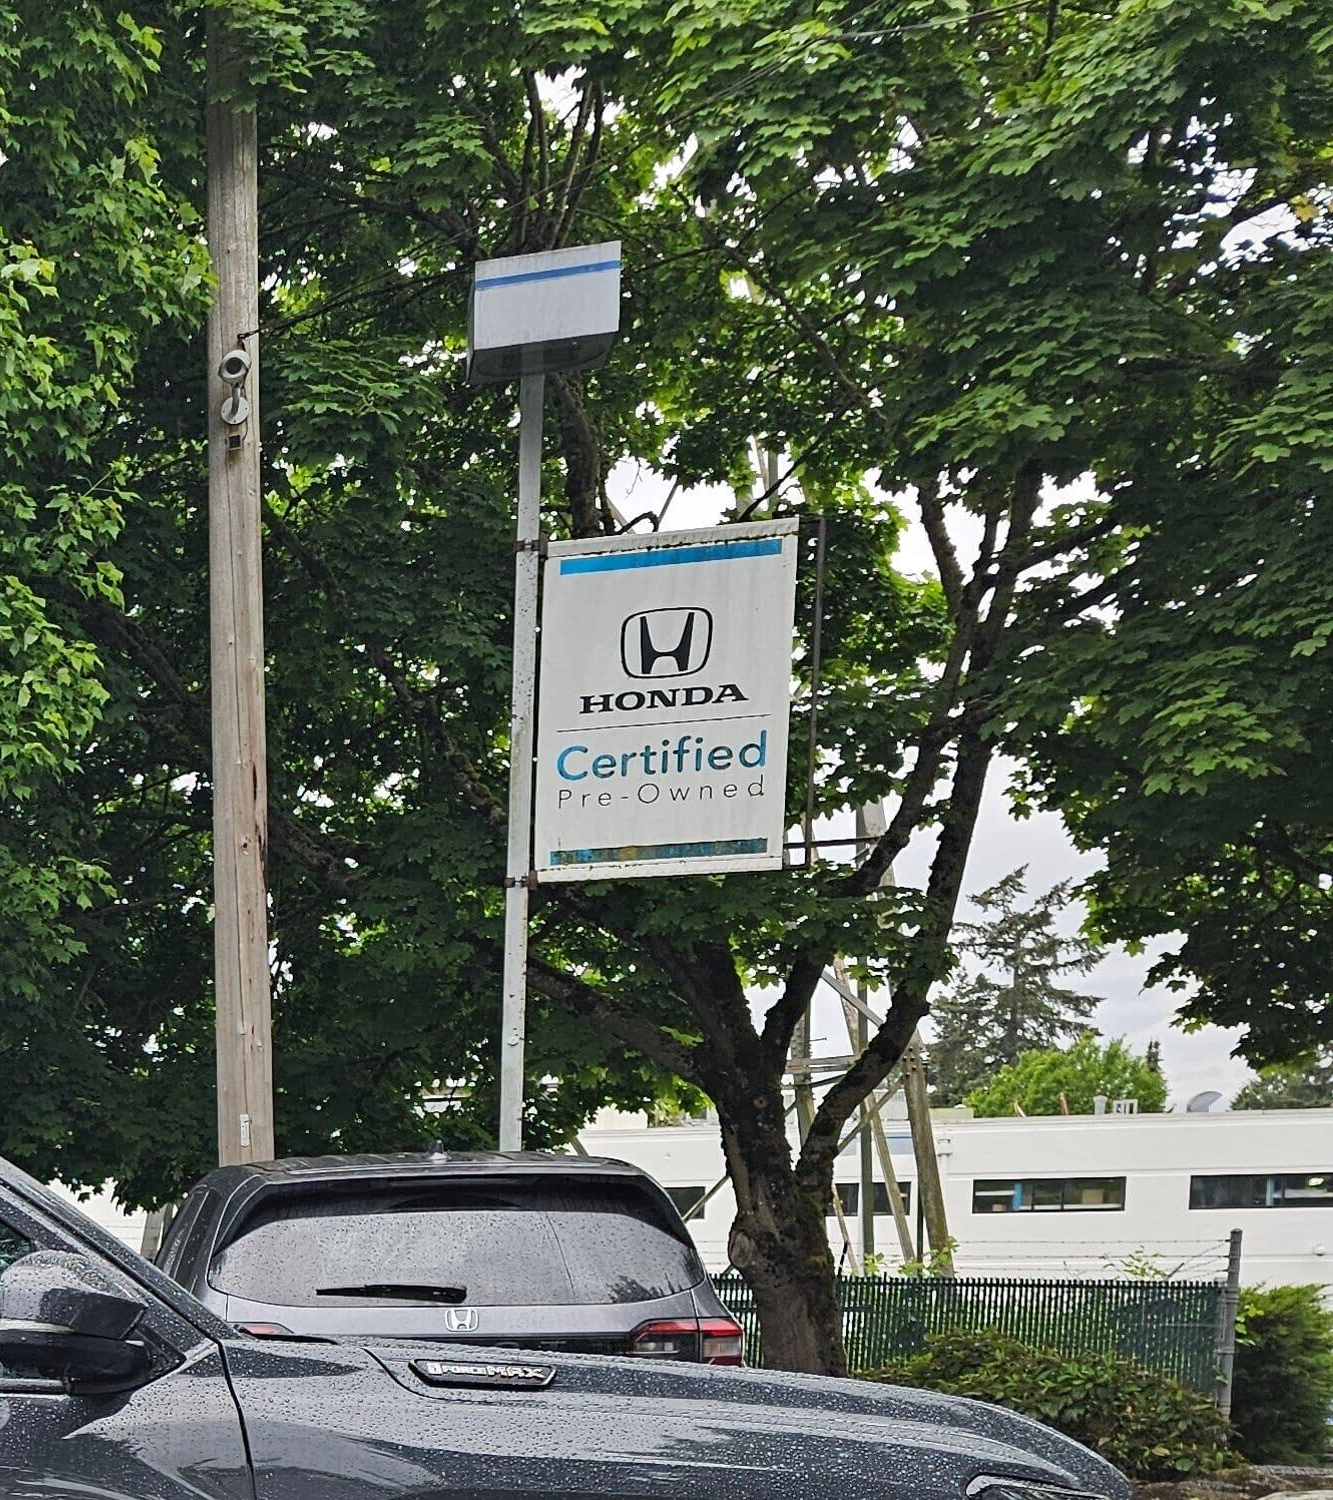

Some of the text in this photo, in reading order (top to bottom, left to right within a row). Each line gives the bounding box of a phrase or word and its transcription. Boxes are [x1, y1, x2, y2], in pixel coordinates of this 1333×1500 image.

[579, 684, 749, 715] HONDA
[556, 729, 767, 782] Certified
[557, 774, 765, 810] Pre-Owned
[486, 1365, 546, 1379] MAX
